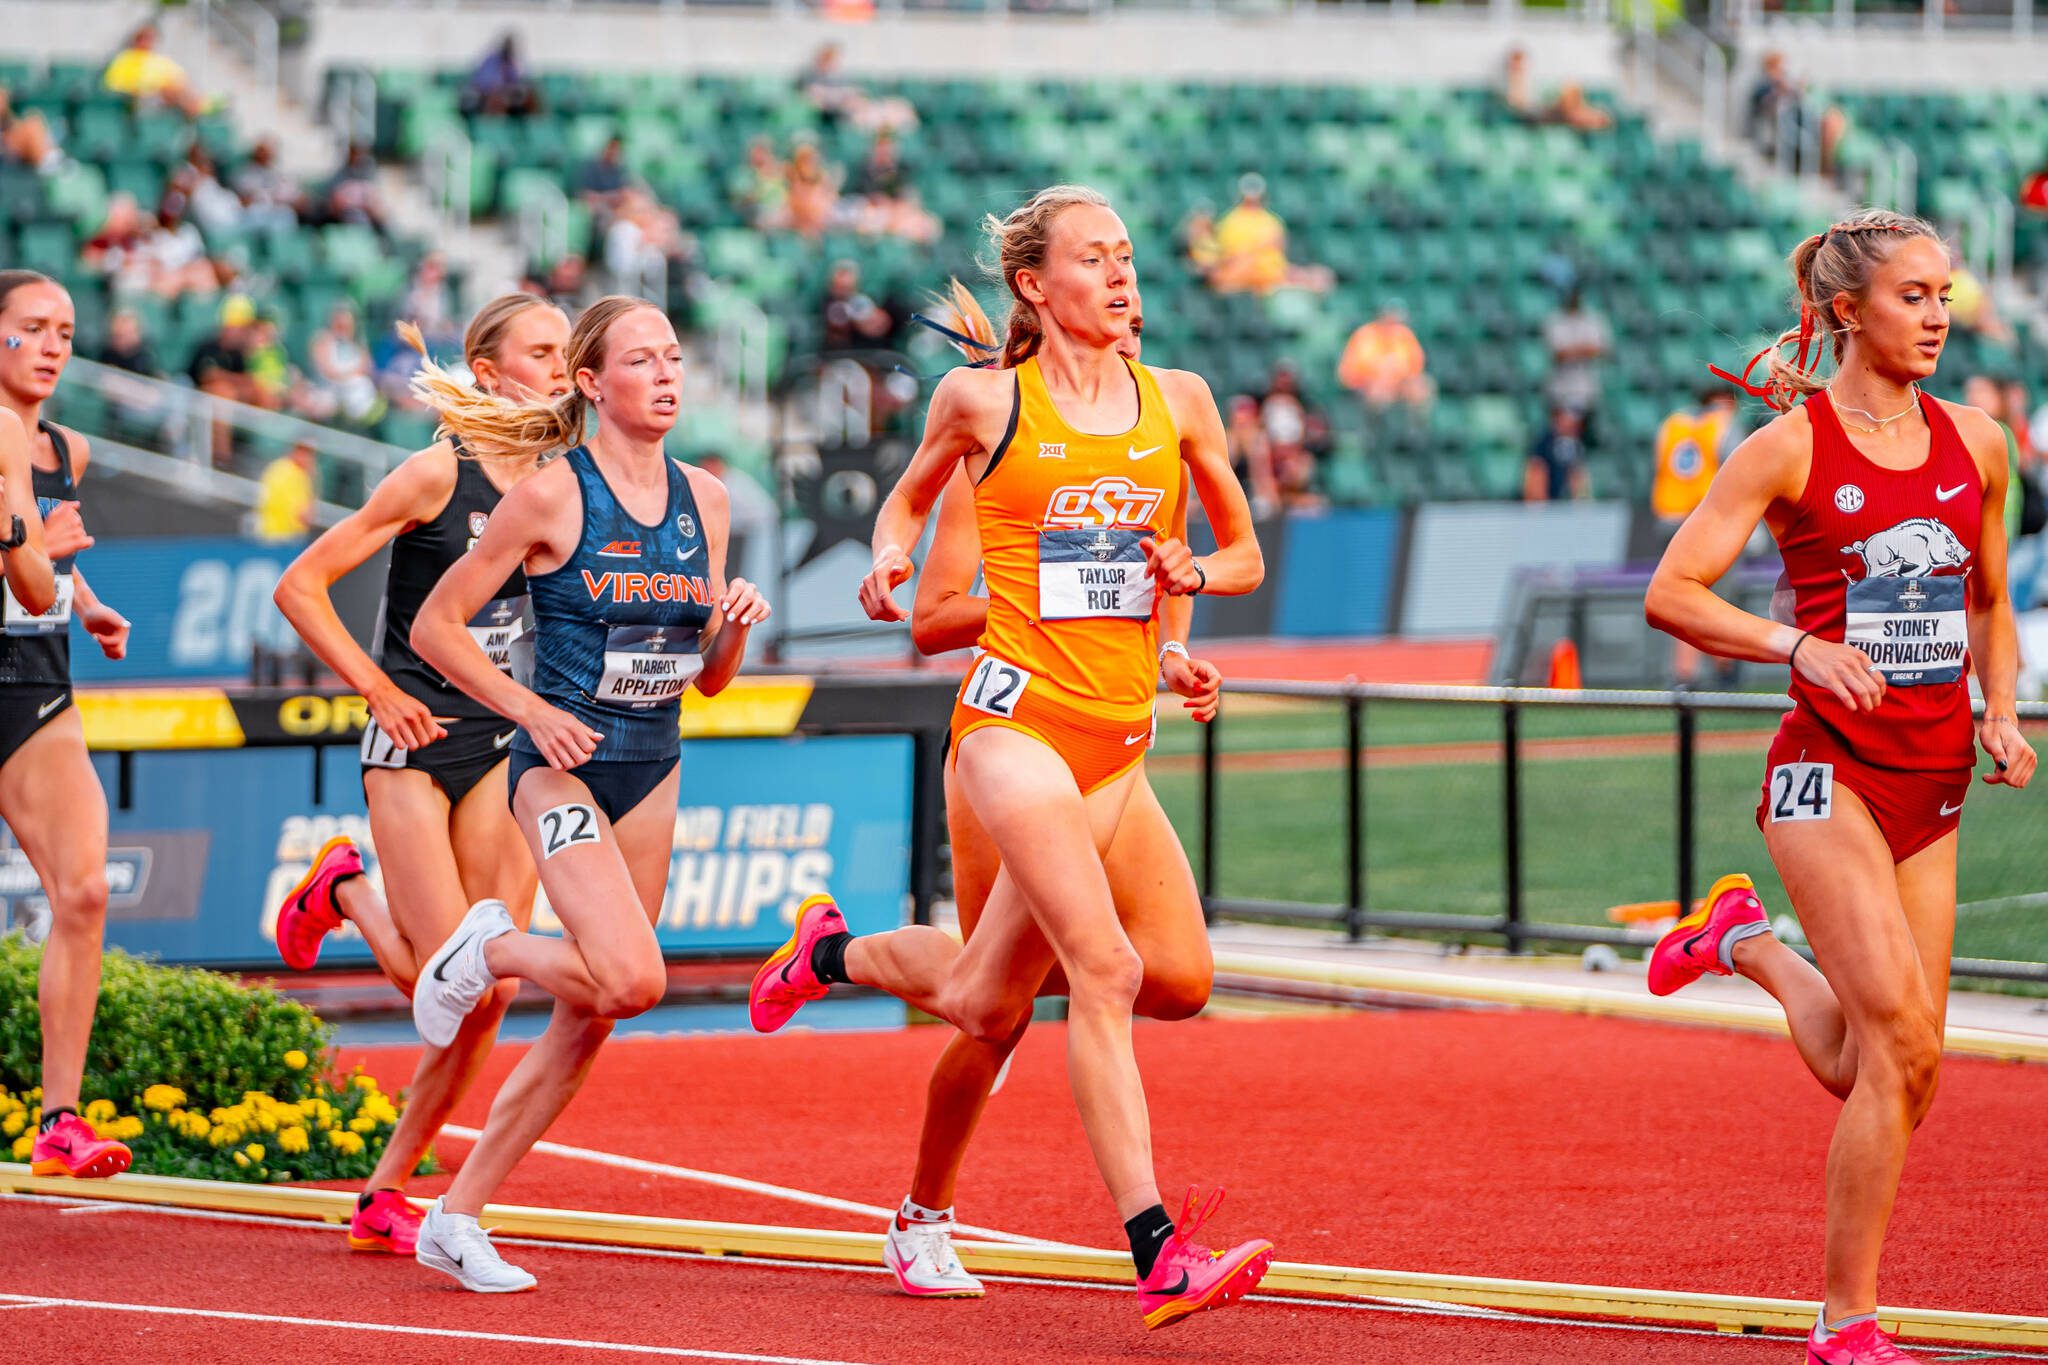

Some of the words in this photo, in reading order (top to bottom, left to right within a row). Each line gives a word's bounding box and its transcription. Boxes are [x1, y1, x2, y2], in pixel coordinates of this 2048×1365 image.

[1045, 478, 1162, 529] OSU
[1835, 485, 1863, 511] SEC
[600, 540, 642, 555] ACC
[1078, 568, 1126, 585] TAYLOR
[1087, 590, 1121, 611] ROE
[1883, 618, 1940, 637] SYDNEY
[486, 631, 509, 646] AM
[631, 658, 678, 675] MARGOT
[611, 677, 689, 697] APPLETON
[973, 660, 1021, 714] 12
[1774, 766, 1828, 819] 24
[543, 805, 595, 854] 22
